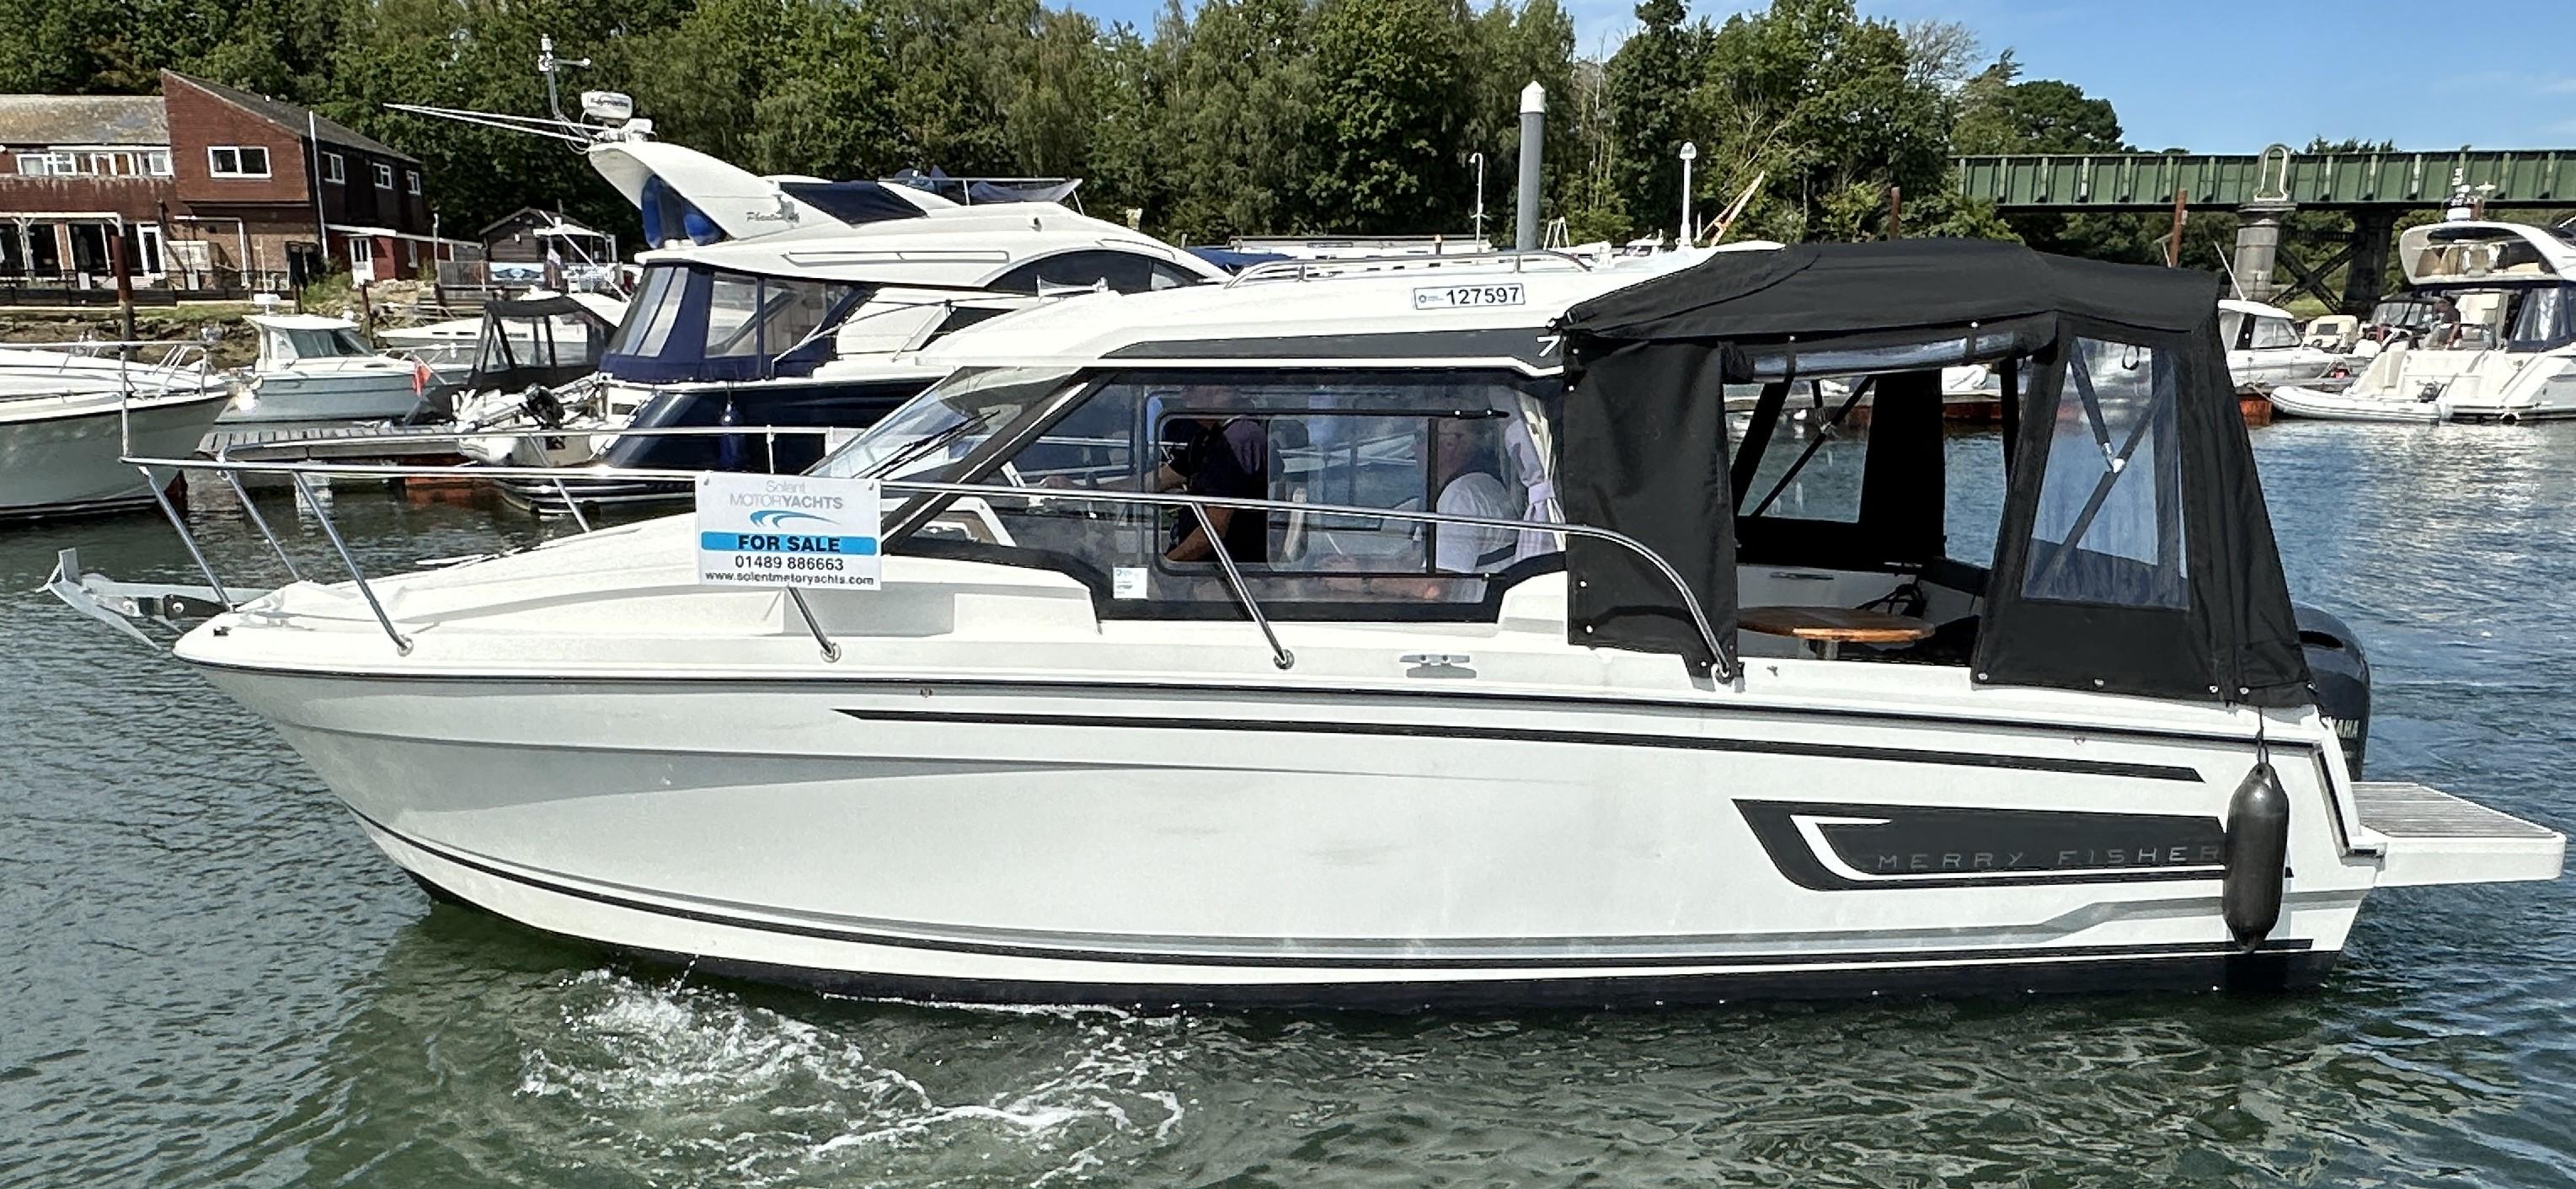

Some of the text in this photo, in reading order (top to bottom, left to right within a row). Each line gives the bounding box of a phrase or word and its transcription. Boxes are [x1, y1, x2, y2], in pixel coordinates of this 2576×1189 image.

[1446, 287, 1520, 306] 127597
[766, 479, 805, 494] Solent
[730, 492, 843, 510] MOTORYACHTS
[738, 535, 841, 553] FOR SALE
[735, 554, 844, 571] 01489 886663
[705, 571, 874, 586] www.solentmotoryachts.com
[1878, 845, 2221, 870] MERRY FISHER
